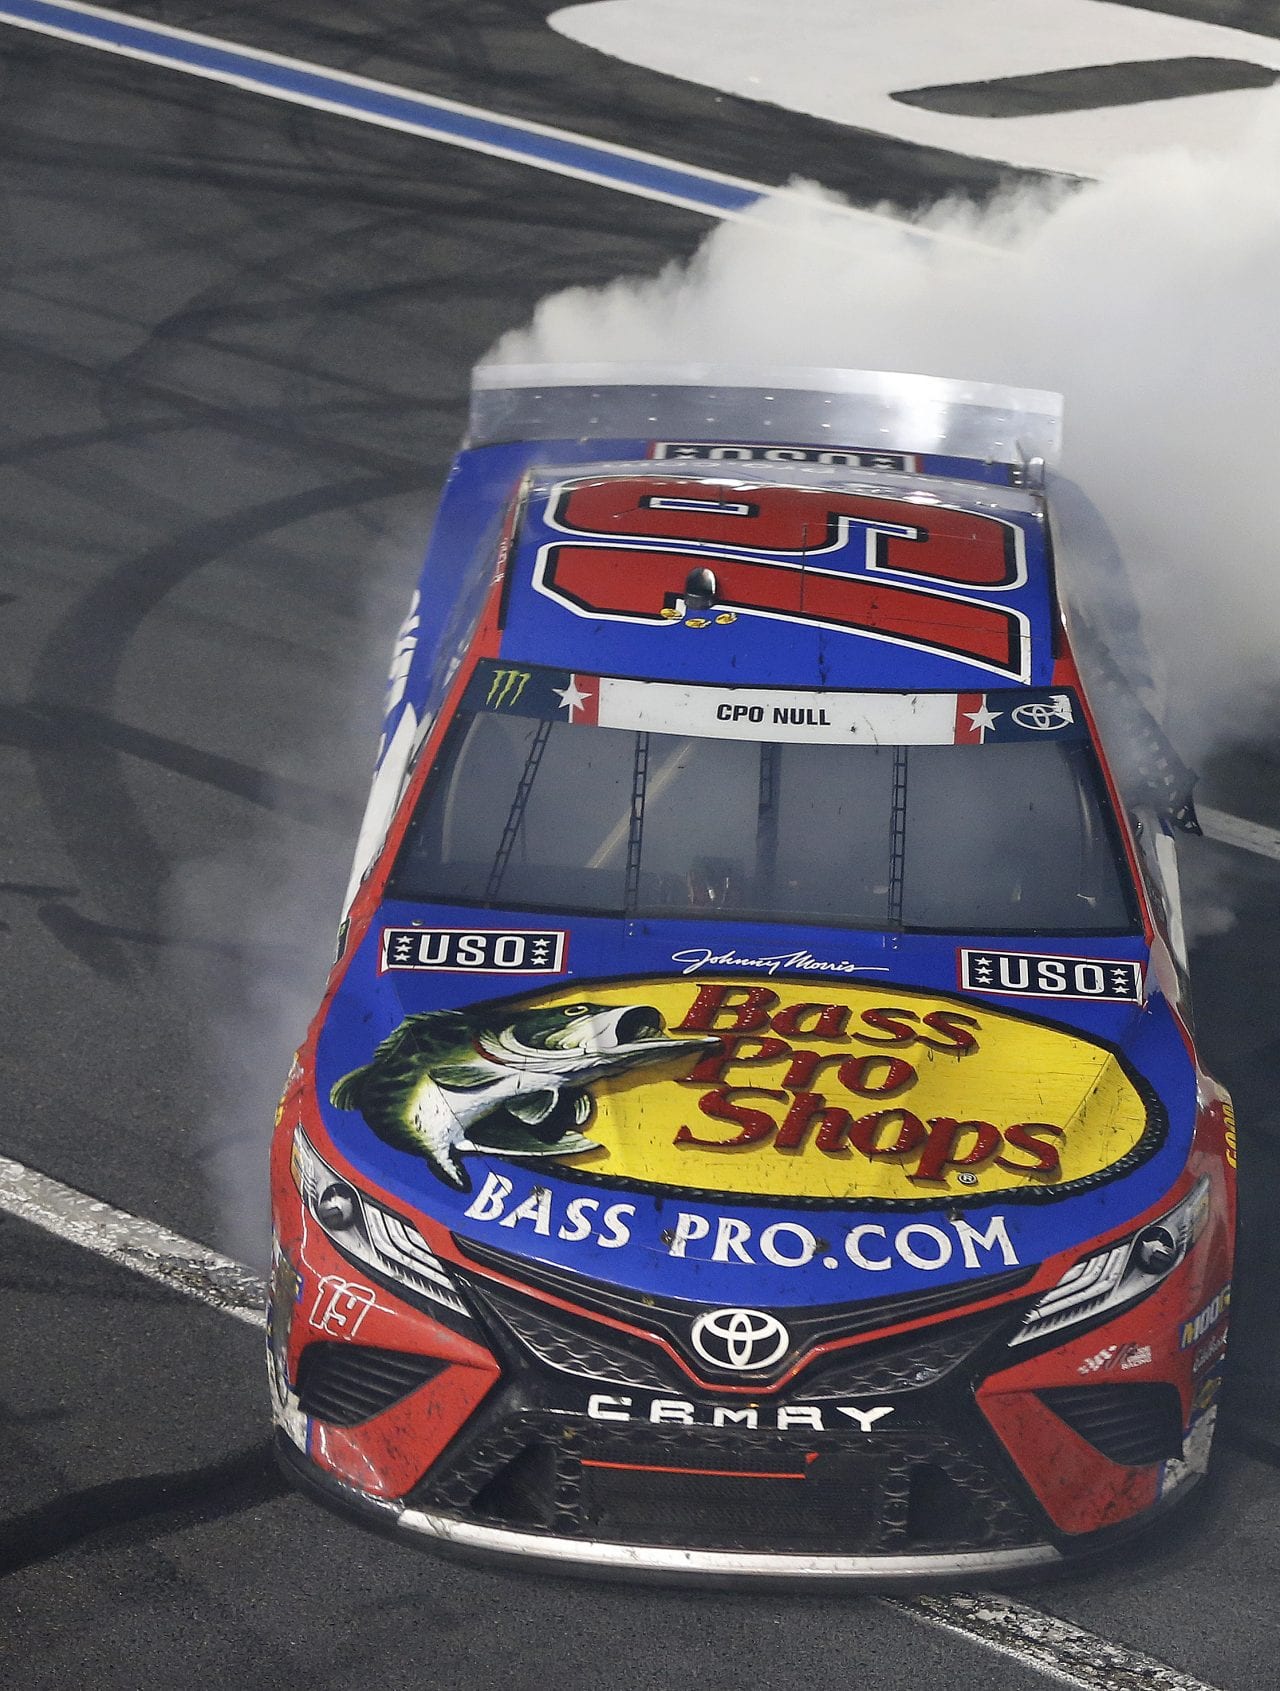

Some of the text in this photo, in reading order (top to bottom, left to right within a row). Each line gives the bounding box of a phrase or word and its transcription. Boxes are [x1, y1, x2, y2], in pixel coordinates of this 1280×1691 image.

[716, 703, 831, 726] CPO NULL
[418, 934, 526, 968] USO
[671, 949, 890, 975] Johnny Morris
[999, 957, 1106, 995] USO
[668, 982, 980, 1056] Bass
[673, 1034, 918, 1100] Pro
[673, 1086, 1066, 1190] Shops
[463, 1171, 1021, 1271] BASS PRO.COM
[307, 1274, 376, 1339] 19
[587, 1394, 895, 1432] CAMRY
